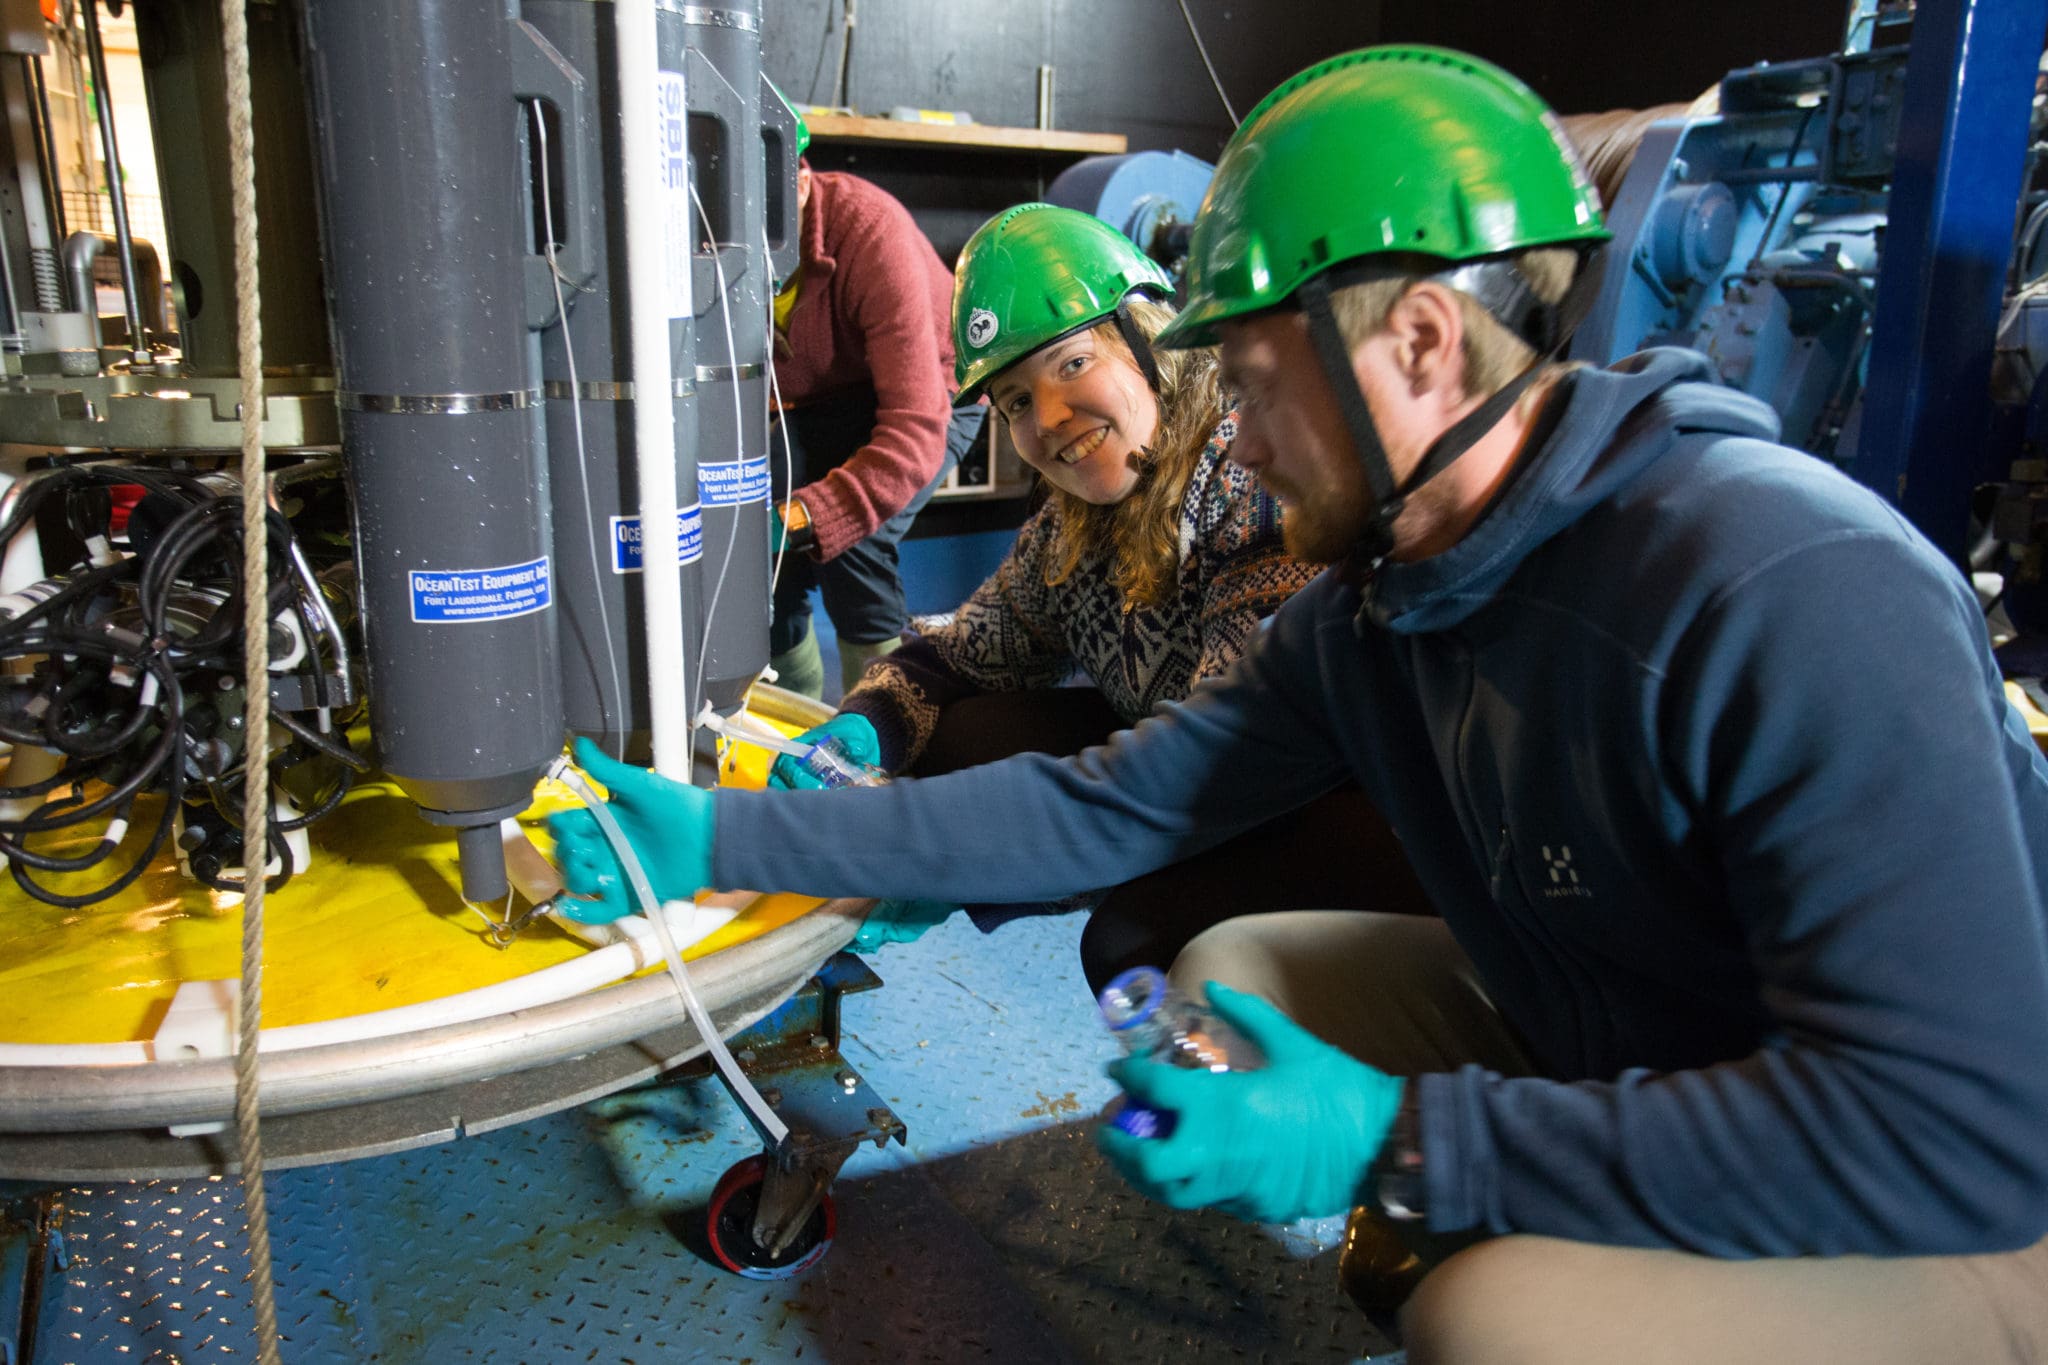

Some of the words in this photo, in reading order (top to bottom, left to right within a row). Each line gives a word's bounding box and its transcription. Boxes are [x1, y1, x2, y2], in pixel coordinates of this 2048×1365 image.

[665, 80, 684, 189] SBE
[415, 576, 480, 592] OCEANTEST
[423, 596, 447, 606] FORT
